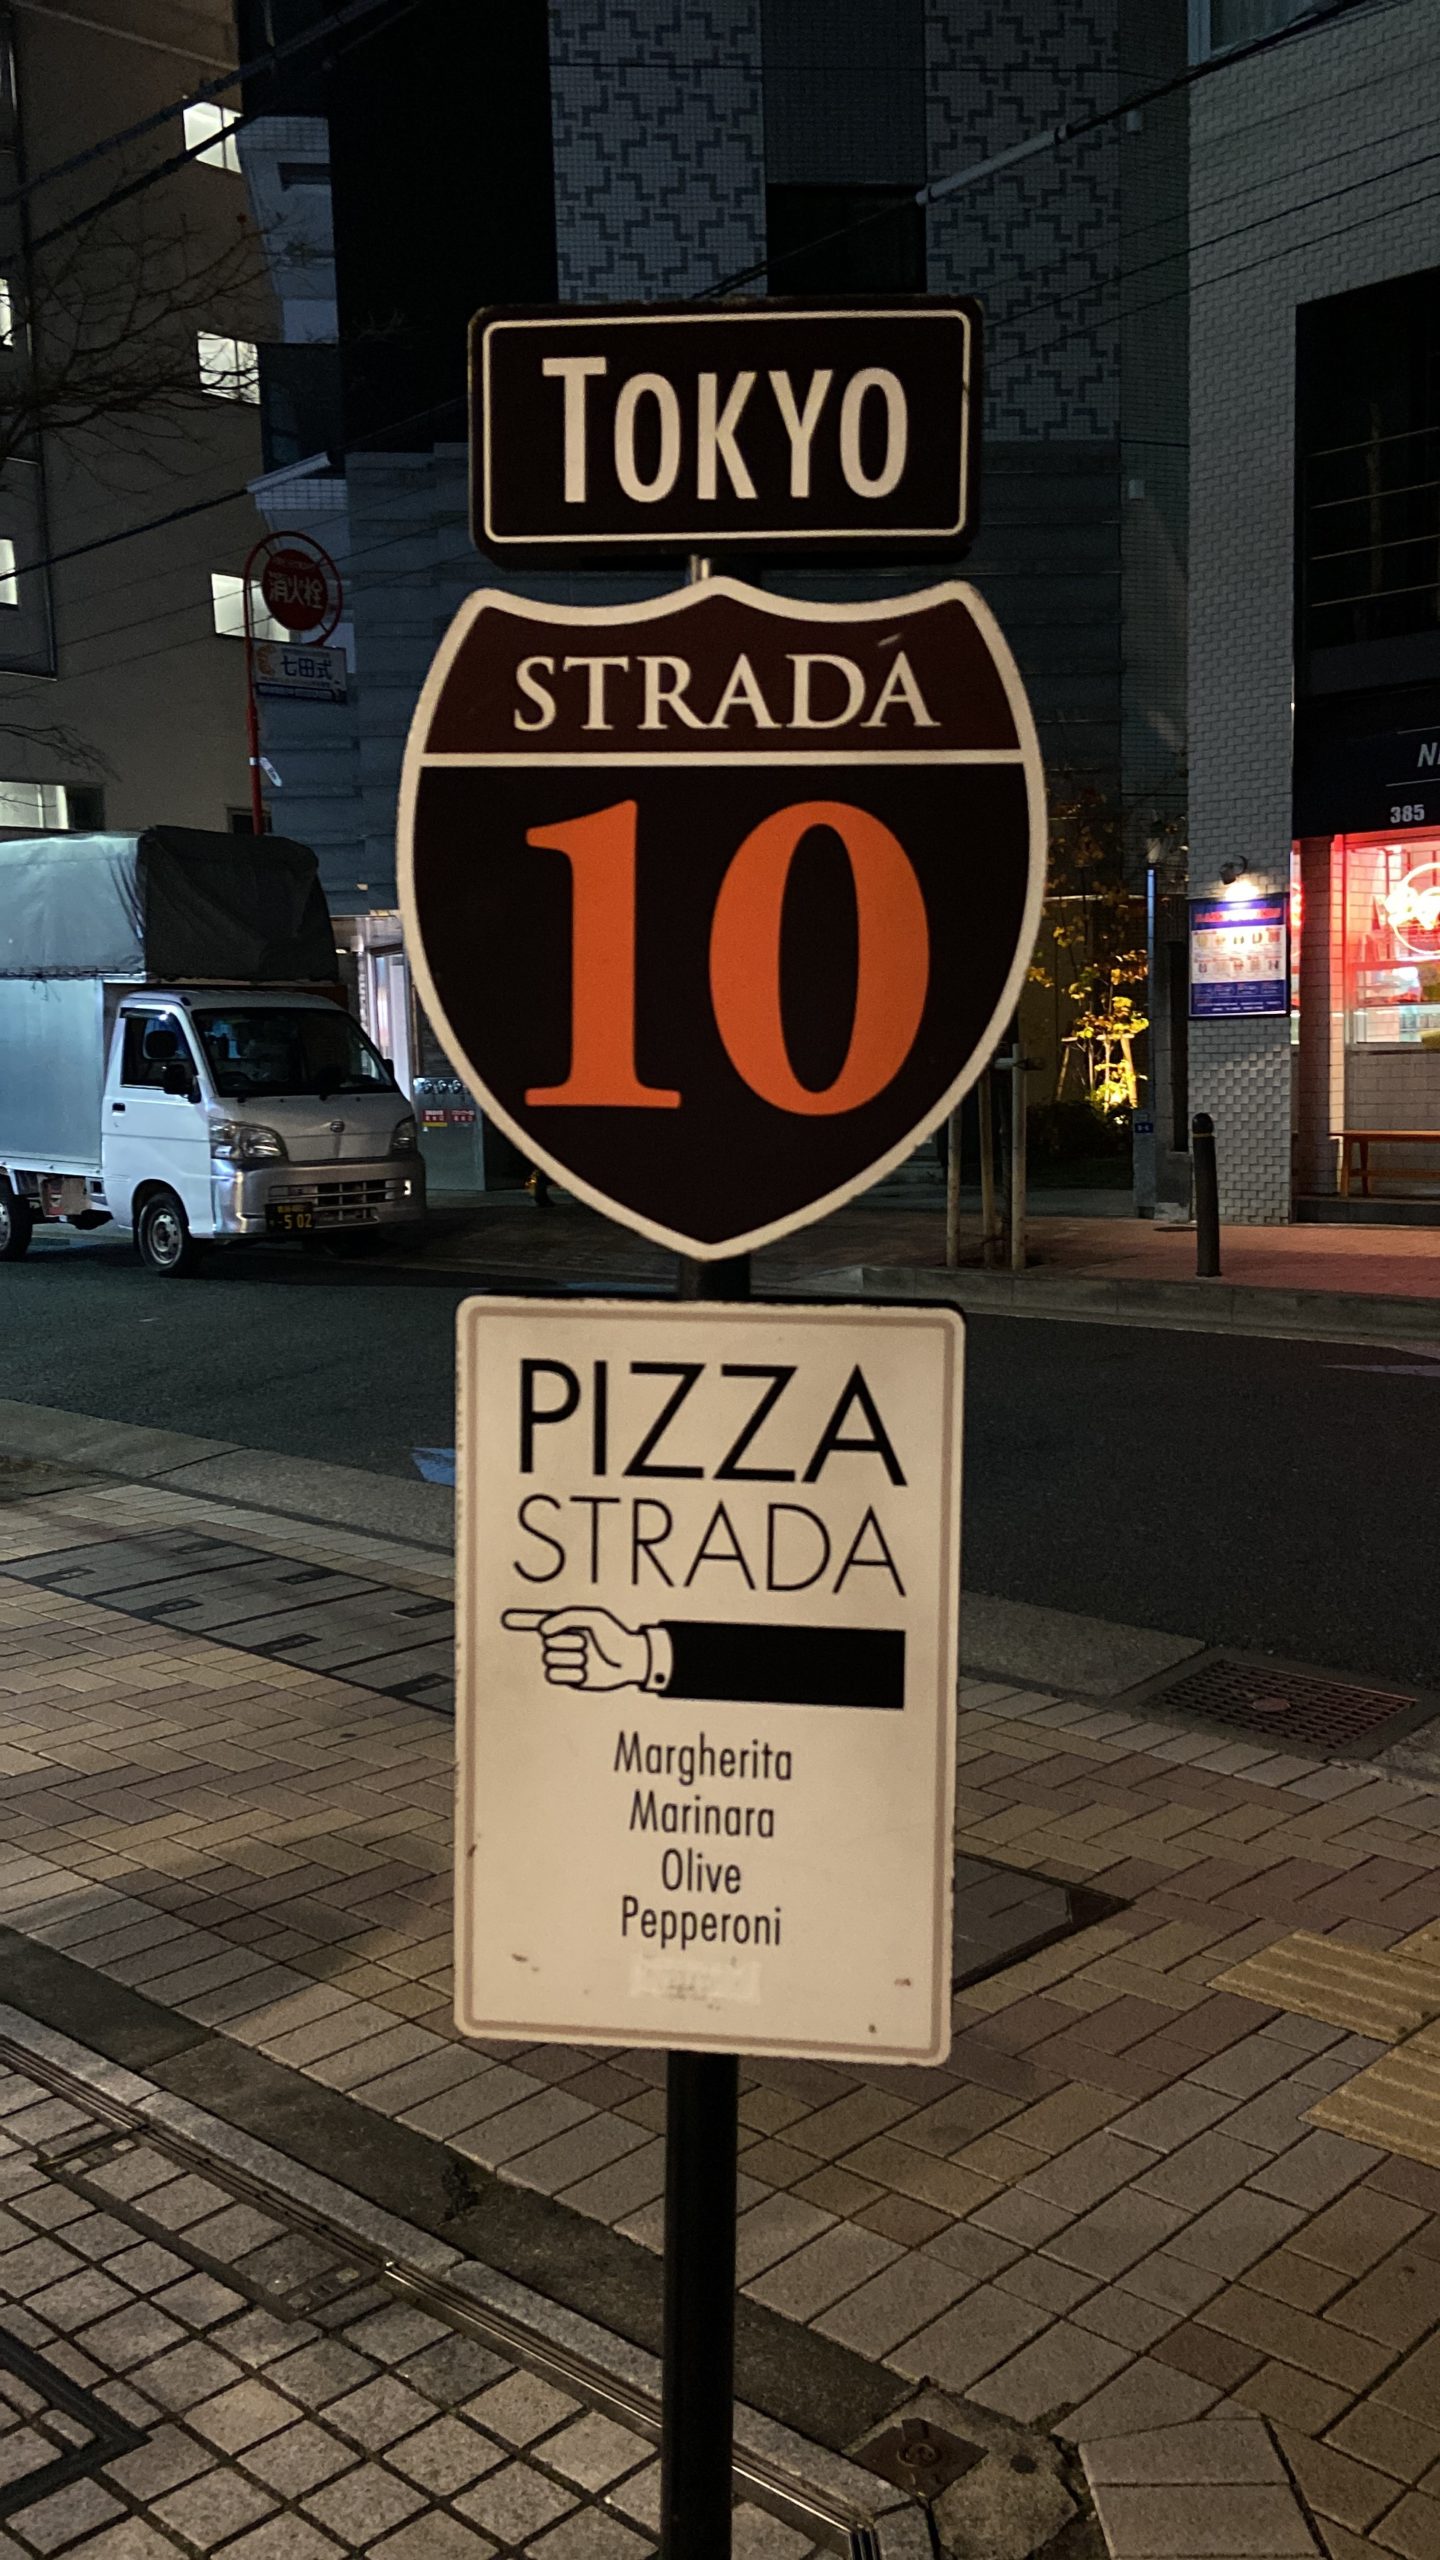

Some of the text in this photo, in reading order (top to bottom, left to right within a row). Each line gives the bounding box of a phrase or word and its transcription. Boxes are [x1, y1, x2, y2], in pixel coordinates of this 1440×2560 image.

[542, 356, 908, 503] TOKYO
[267, 571, 325, 610] 消火栓
[281, 655, 332, 680] 七田式
[514, 651, 941, 732] STRADA
[1389, 804, 1425, 824] 385
[523, 797, 931, 1118] 10
[520, 1358, 908, 1487] PIZZA
[513, 1493, 907, 1598] STRADA
[613, 1730, 793, 1786] Margherita
[629, 1789, 775, 1839] Marinara
[661, 1847, 742, 1895] Olive
[621, 1895, 782, 1951] Pepperoni
